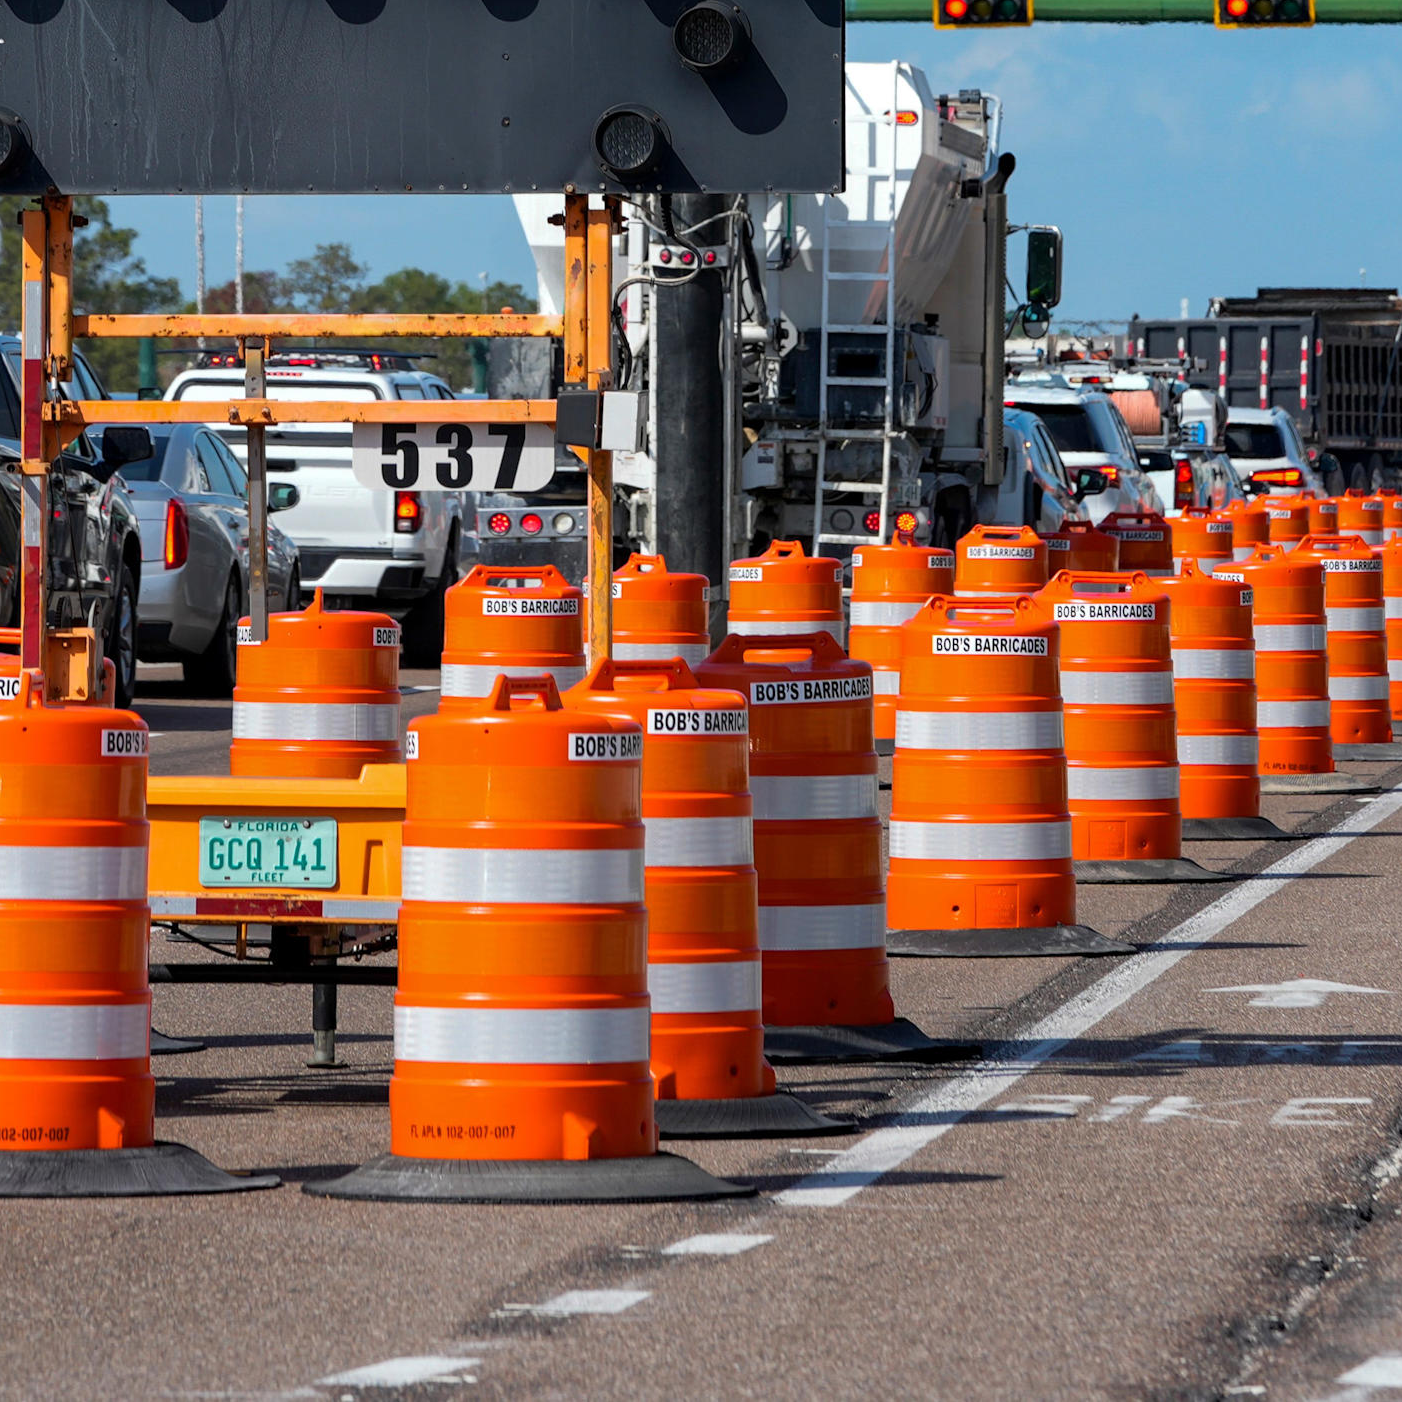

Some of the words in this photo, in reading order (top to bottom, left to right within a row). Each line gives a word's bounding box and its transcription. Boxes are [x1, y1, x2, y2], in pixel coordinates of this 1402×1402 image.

[381, 423, 526, 490] 537
[968, 548, 988, 557] BOB'S
[989, 548, 1033, 558] BARRICADES
[486, 600, 518, 613] BOB'S
[521, 600, 577, 613] BARRICADES
[1056, 604, 1086, 618] BOB'S
[1089, 604, 1154, 618] BARRICADES
[935, 638, 970, 652] BOB'S
[975, 638, 1046, 654] BARRICADES
[754, 683, 799, 703] BOB'S
[803, 677, 871, 702] BARRICADES
[653, 711, 699, 732] BOB'S
[106, 731, 140, 753] BOB'S
[574, 734, 616, 757] BOB'S
[237, 821, 300, 832] FLORIDA
[208, 836, 263, 871] GCQ
[274, 836, 326, 871] 141
[251, 872, 285, 883] FLEET
[986, 1094, 1374, 1125] BIKE
[446, 1124, 516, 1140] 102-007-007
